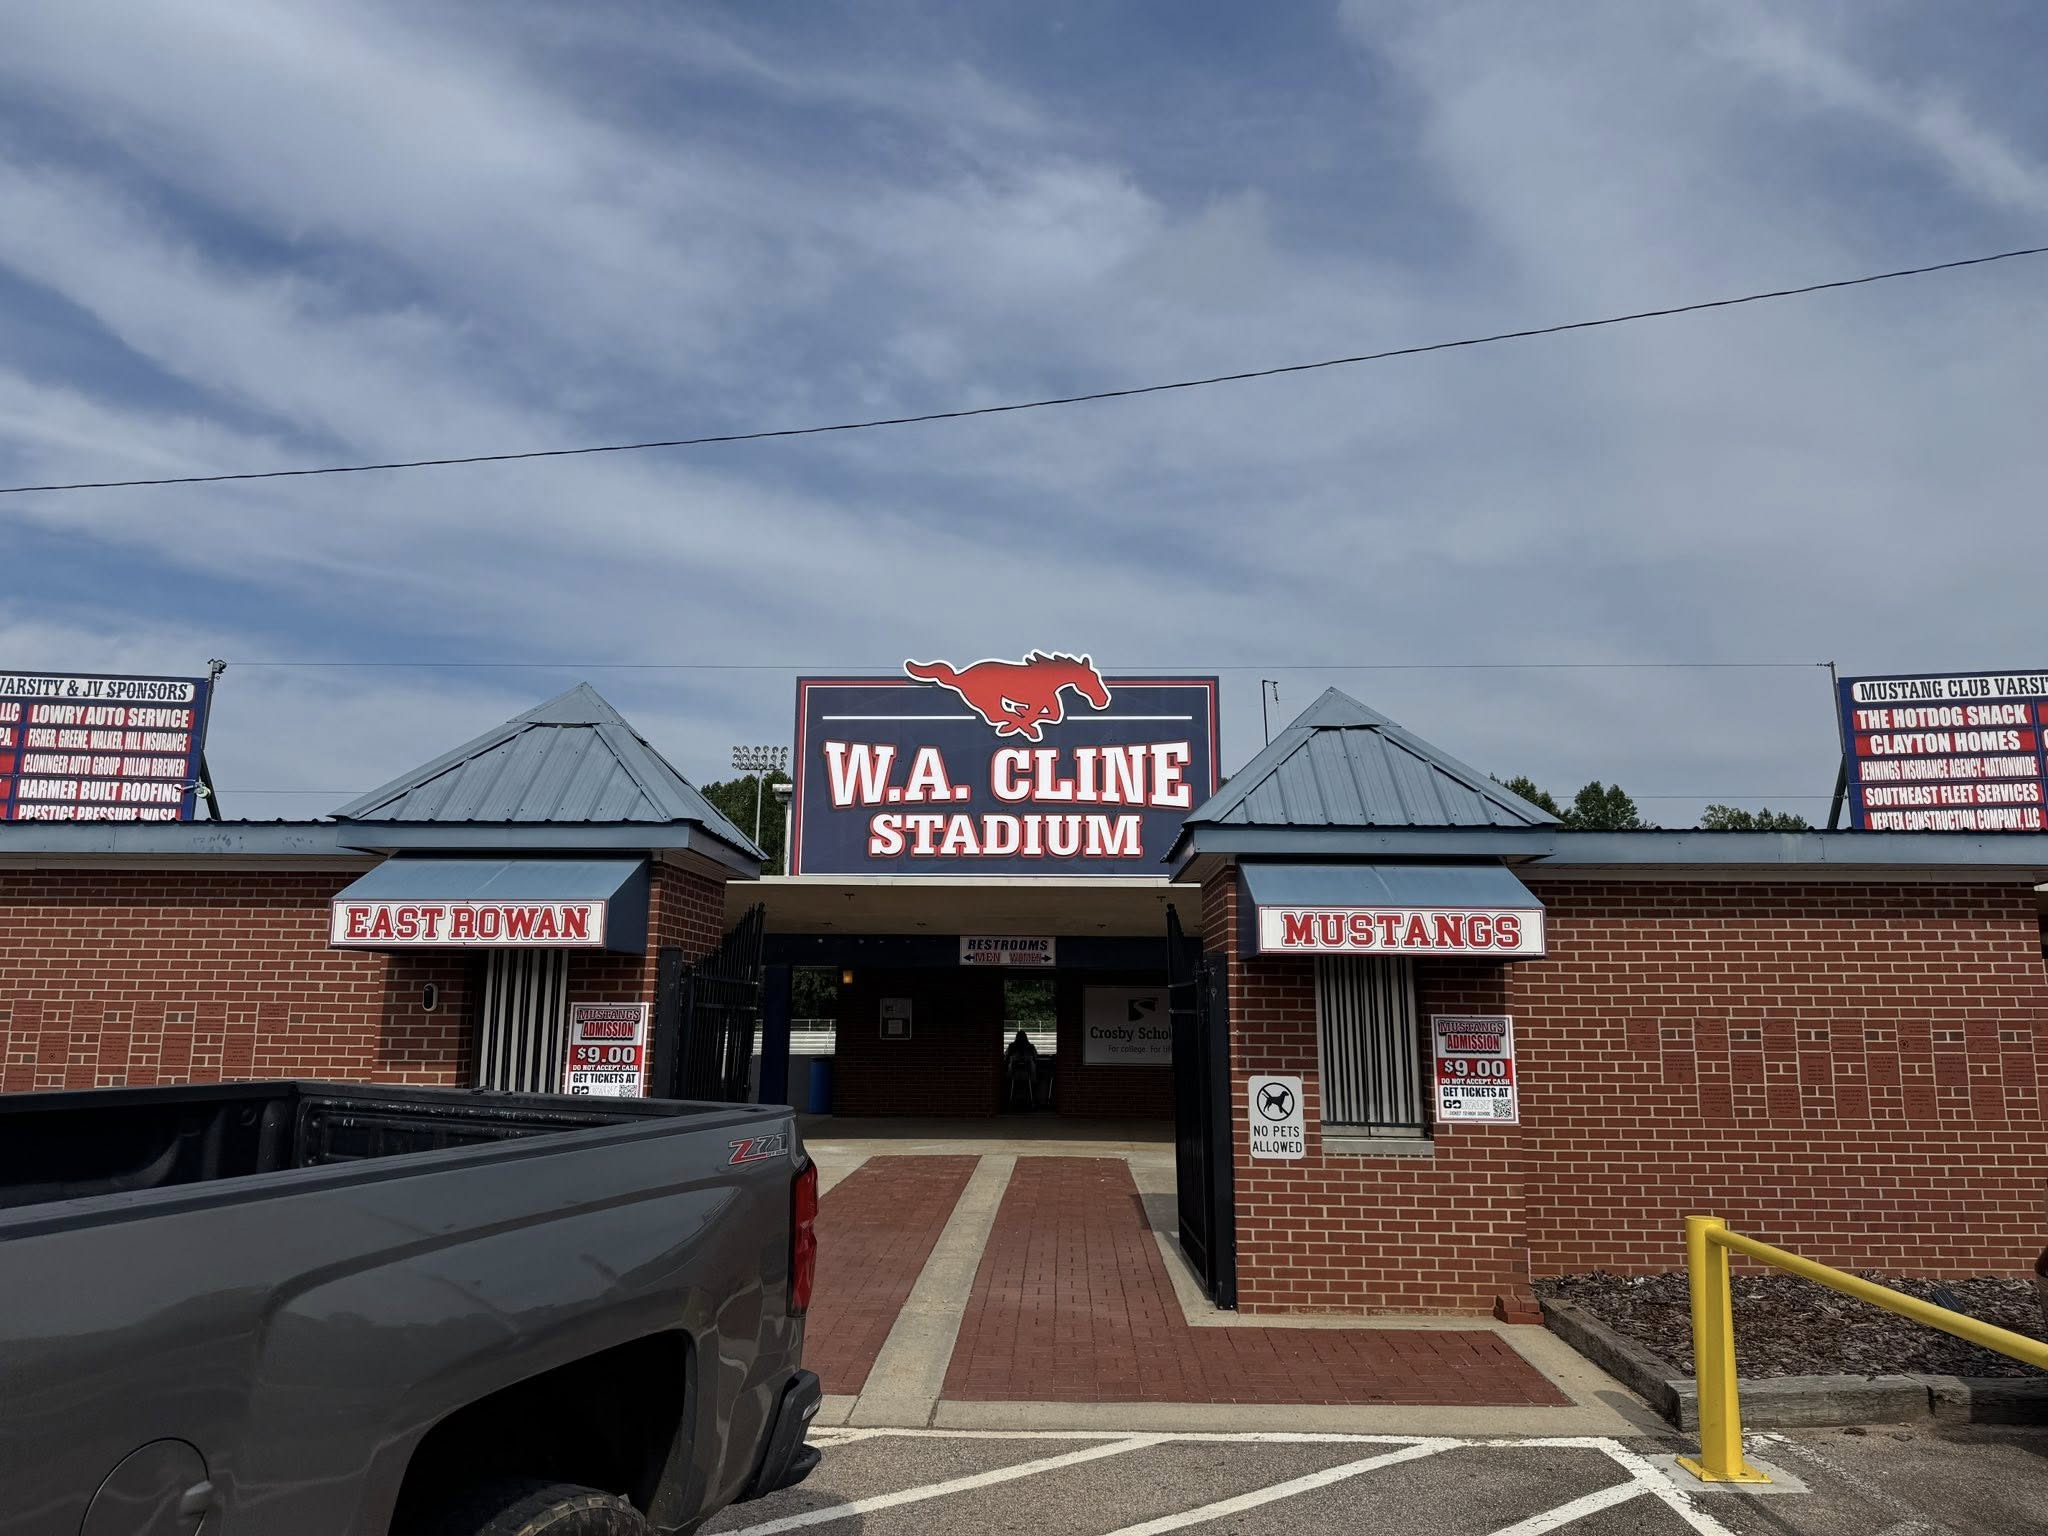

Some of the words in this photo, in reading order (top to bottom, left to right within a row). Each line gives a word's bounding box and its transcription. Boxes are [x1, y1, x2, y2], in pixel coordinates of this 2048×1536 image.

[67, 680, 79, 697] &
[83, 681, 103, 697] JV
[107, 681, 188, 701] SPONSORS
[1860, 680, 1943, 701] MUSTANG
[1948, 678, 1991, 698] CLUB
[32, 704, 85, 725] LOWRY
[85, 706, 125, 726] AUTO
[127, 707, 190, 728] SERVICE
[1857, 709, 1890, 729] THE
[1892, 706, 1964, 729] HOTDOG
[1966, 704, 2028, 726] SHACK
[27, 728, 57, 750] FISHER,
[58, 729, 89, 751] GREENE,
[90, 730, 123, 751] WALKER,
[124, 731, 142, 750] HILL
[142, 732, 188, 752] INSURANCE
[1870, 732, 1951, 755] CLAYTON
[1954, 730, 2021, 752] HOMES
[23, 753, 68, 774] CLONINGER
[68, 756, 91, 775] AUTO
[92, 756, 121, 776] GROUP
[122, 757, 151, 776] DILLON
[151, 758, 186, 777] BREWER
[825, 742, 970, 806] W.A.
[991, 740, 1192, 809] CLINE
[1861, 761, 1901, 781] JENNINGS
[1901, 759, 1949, 780] INSURANCE
[18, 779, 78, 800] HARMER
[80, 781, 120, 801] BUILT
[121, 783, 182, 803] ROOFING
[1865, 786, 1938, 806] SOUTHEAST
[1940, 784, 1974, 804] FLEET
[1976, 783, 2039, 803] SERVICES
[18, 804, 77, 820] PRESTIGE
[77, 806, 138, 821] PRESSURE
[140, 807, 177, 821] WASH
[1870, 812, 1905, 831] VERTEX
[1905, 809, 1976, 831] CONSTRUCTION
[1976, 809, 2023, 830] COMPANY,
[2023, 808, 2041, 828] LLC
[869, 814, 1143, 857] STADIUM
[345, 905, 446, 940] EAST
[449, 905, 591, 940] ROWAN
[1281, 912, 1522, 949] MUSTANGS
[968, 939, 1048, 951] RESTROOMS
[975, 952, 1000, 962] MEN
[1009, 953, 1042, 962] WOMEN
[577, 1008, 641, 1022] MUSTANGS
[582, 1021, 635, 1038] ADMISSION
[1090, 1026, 1134, 1042] Crosby
[1440, 1021, 1505, 1034] MUSTANGS
[1108, 1045, 1120, 1053] For
[1150, 1045, 1161, 1053] For
[1446, 1034, 1500, 1050] ADMISSION
[577, 1046, 636, 1063] $9.00
[573, 1073, 589, 1083] GET
[589, 1073, 624, 1083] TICKETS
[625, 1073, 637, 1083] AT
[1444, 1060, 1506, 1077] $9.00
[1443, 1087, 1460, 1097] GET
[1461, 1087, 1497, 1098] TICKETS
[1498, 1087, 1509, 1098] AT
[1253, 1125, 1269, 1137] NO
[1273, 1125, 1300, 1138] PETS
[728, 1132, 789, 1165] Z71
